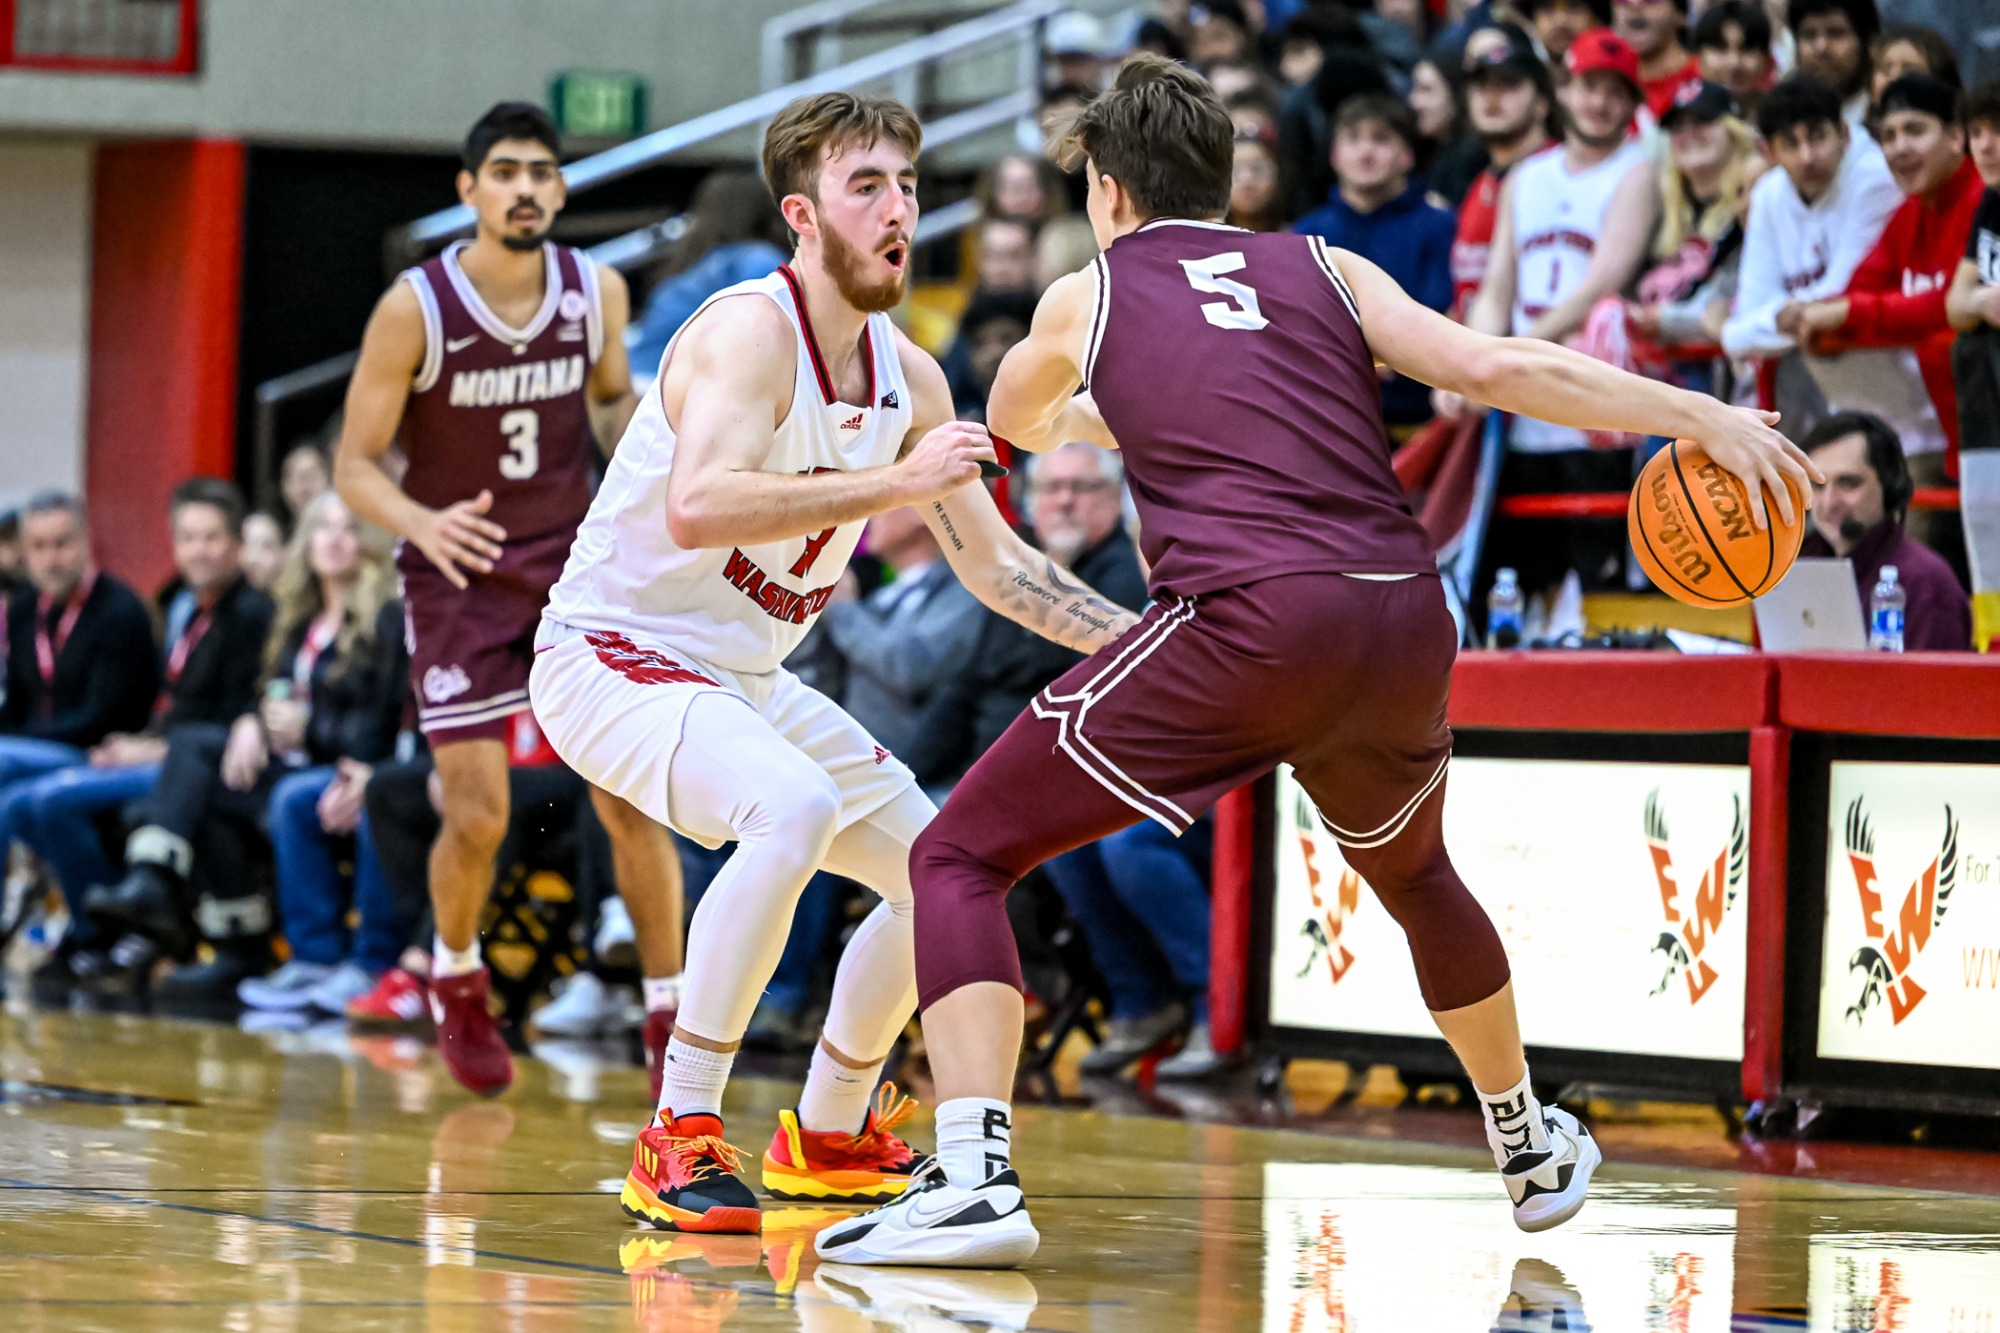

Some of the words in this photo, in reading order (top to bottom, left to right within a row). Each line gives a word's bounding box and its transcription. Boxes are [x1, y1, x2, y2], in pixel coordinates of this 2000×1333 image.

[1178, 251, 1270, 330] 5
[449, 353, 585, 407] MONTANA
[499, 408, 540, 480] 3
[1651, 469, 1712, 585] Wilson
[1695, 461, 1752, 542] NCAA
[1012, 570, 1062, 605] Persevere
[1065, 600, 1116, 635] through
[1966, 854, 1991, 884] For
